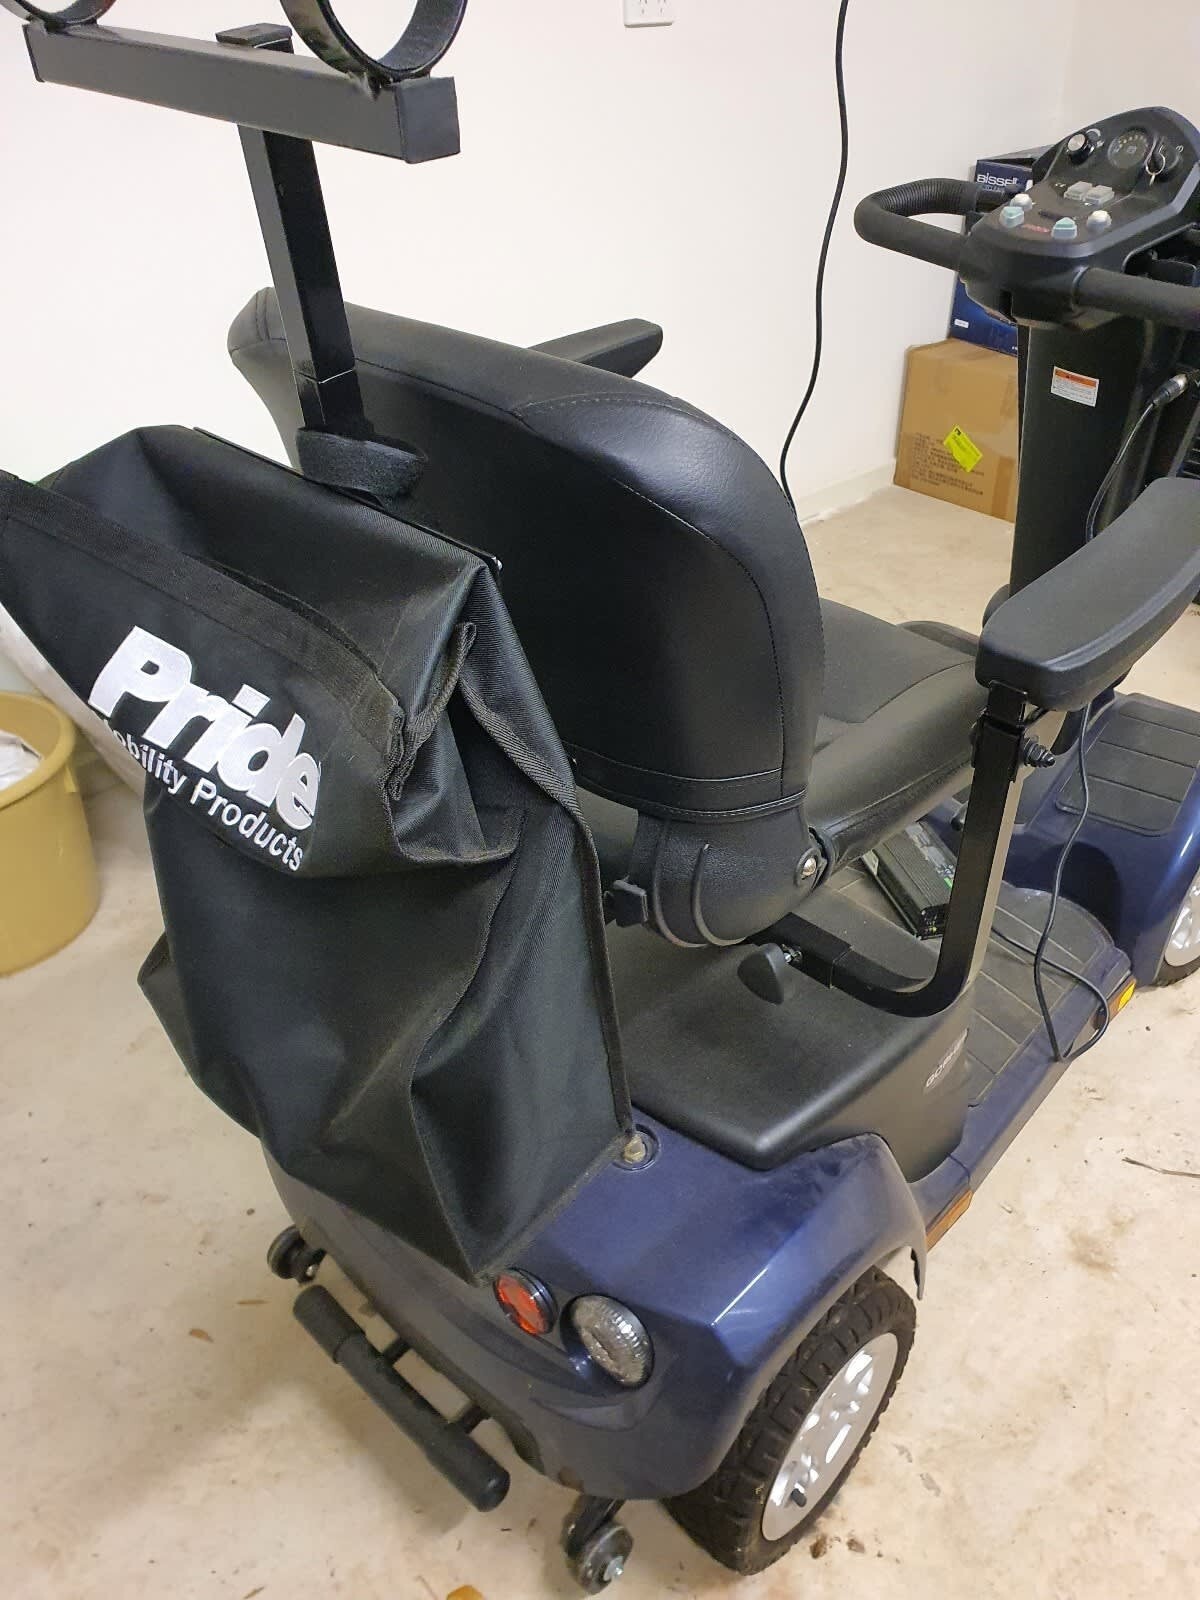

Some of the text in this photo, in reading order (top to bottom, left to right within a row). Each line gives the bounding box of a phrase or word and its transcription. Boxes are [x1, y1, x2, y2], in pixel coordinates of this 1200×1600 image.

[88, 625, 322, 830] Pride
[103, 718, 304, 872] obility Products
